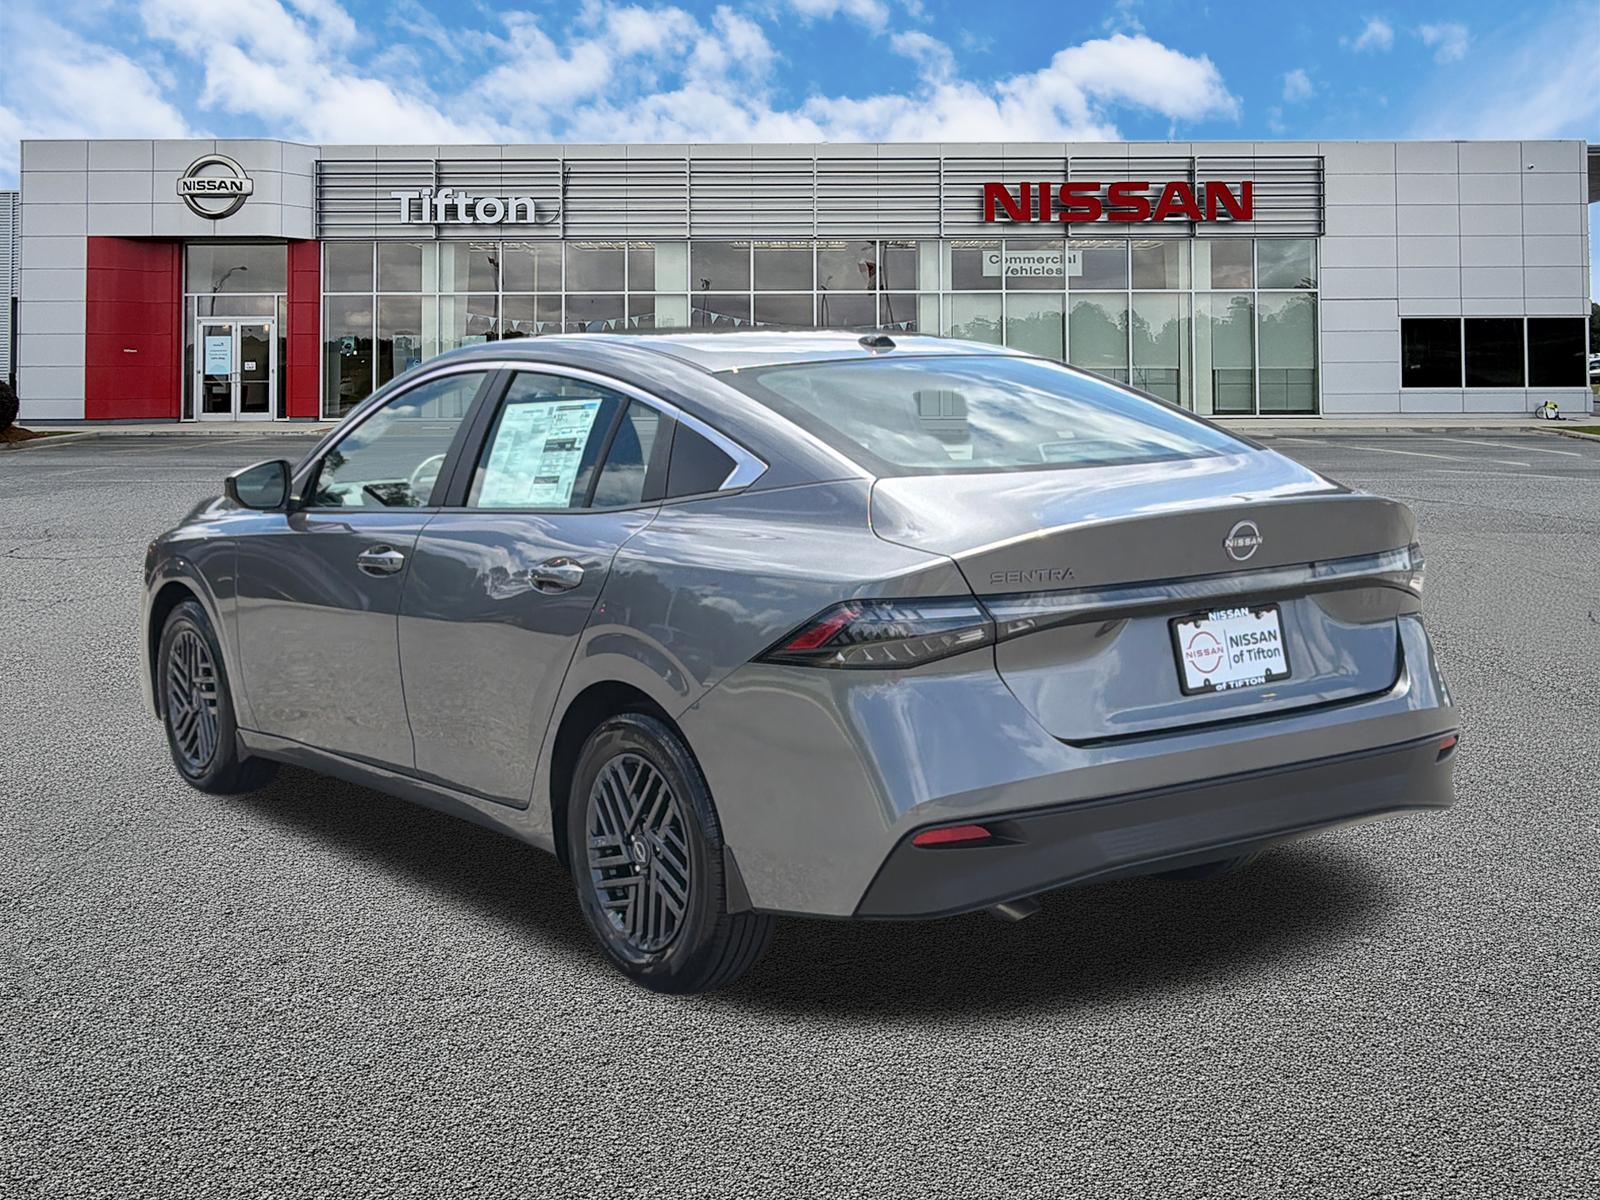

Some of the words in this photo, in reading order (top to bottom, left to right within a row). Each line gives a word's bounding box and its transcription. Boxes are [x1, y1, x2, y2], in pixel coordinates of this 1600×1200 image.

[183, 180, 243, 191] NISSAN
[391, 187, 536, 224] Tifton
[983, 181, 1254, 223] NISSAN
[1225, 536, 1263, 547] NISSAN
[990, 567, 1075, 585] SENTRA
[1208, 607, 1249, 621] NISSAN
[1229, 629, 1278, 648] NISSAN
[1185, 646, 1224, 659] NISSAN
[1232, 652, 1244, 664] of
[1246, 647, 1281, 662] Tifton
[1215, 682, 1227, 691] of
[1230, 676, 1266, 688] TIFTON
